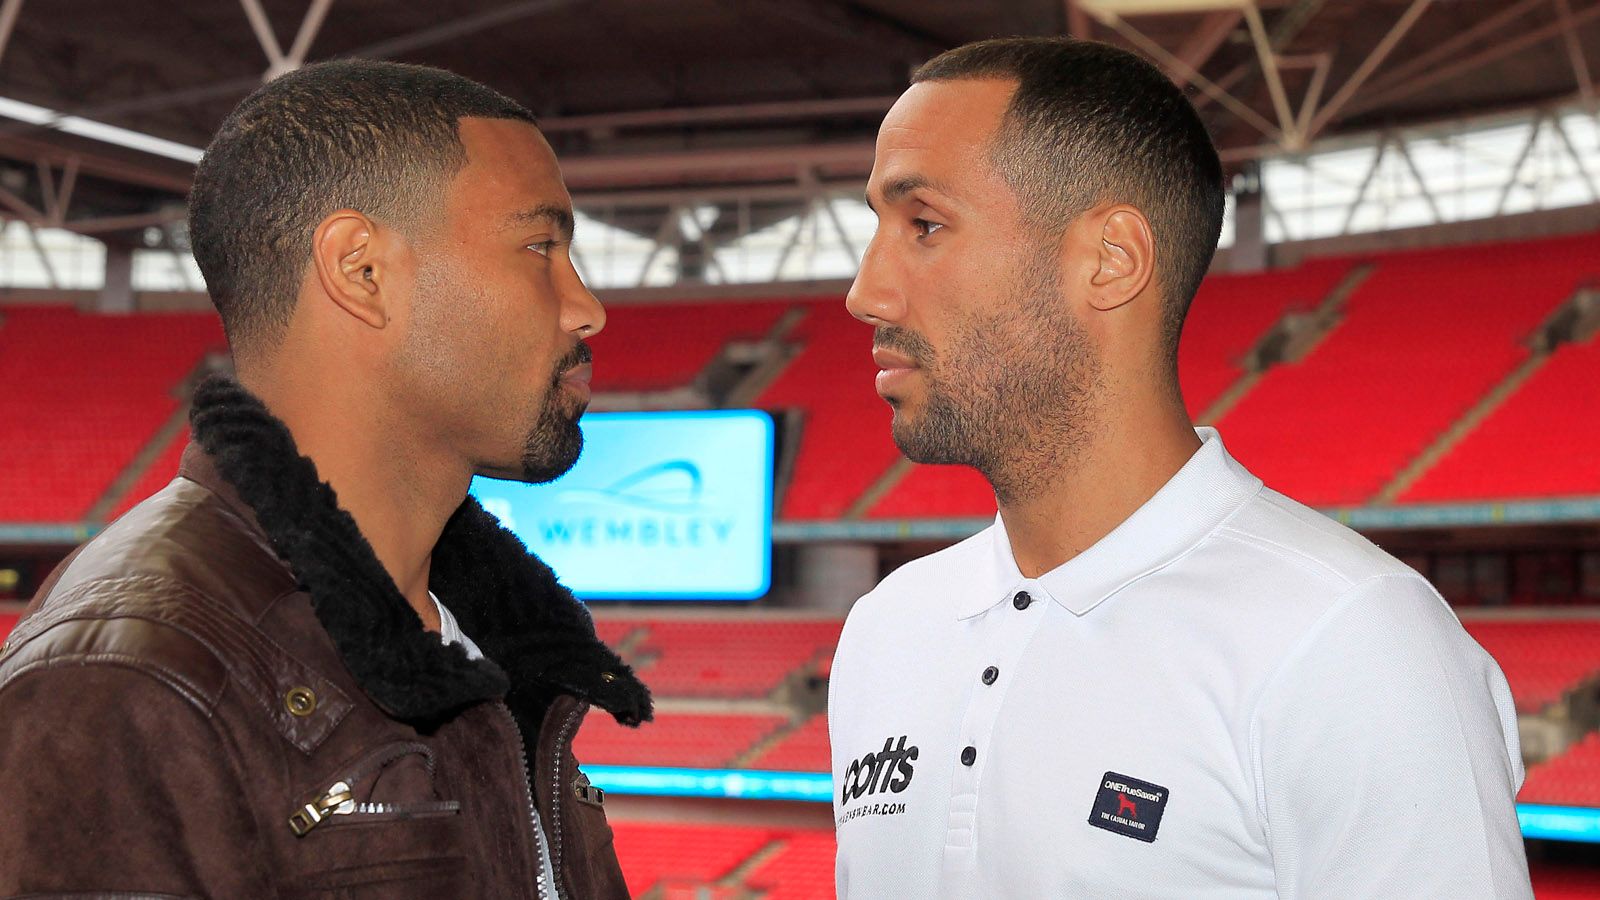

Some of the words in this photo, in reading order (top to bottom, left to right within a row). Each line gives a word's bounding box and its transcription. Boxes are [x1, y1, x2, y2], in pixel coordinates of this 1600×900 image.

[538, 516, 736, 546] WEMBLEY
[842, 735, 919, 806] cotts
[1110, 814, 1128, 826] CASUAL
